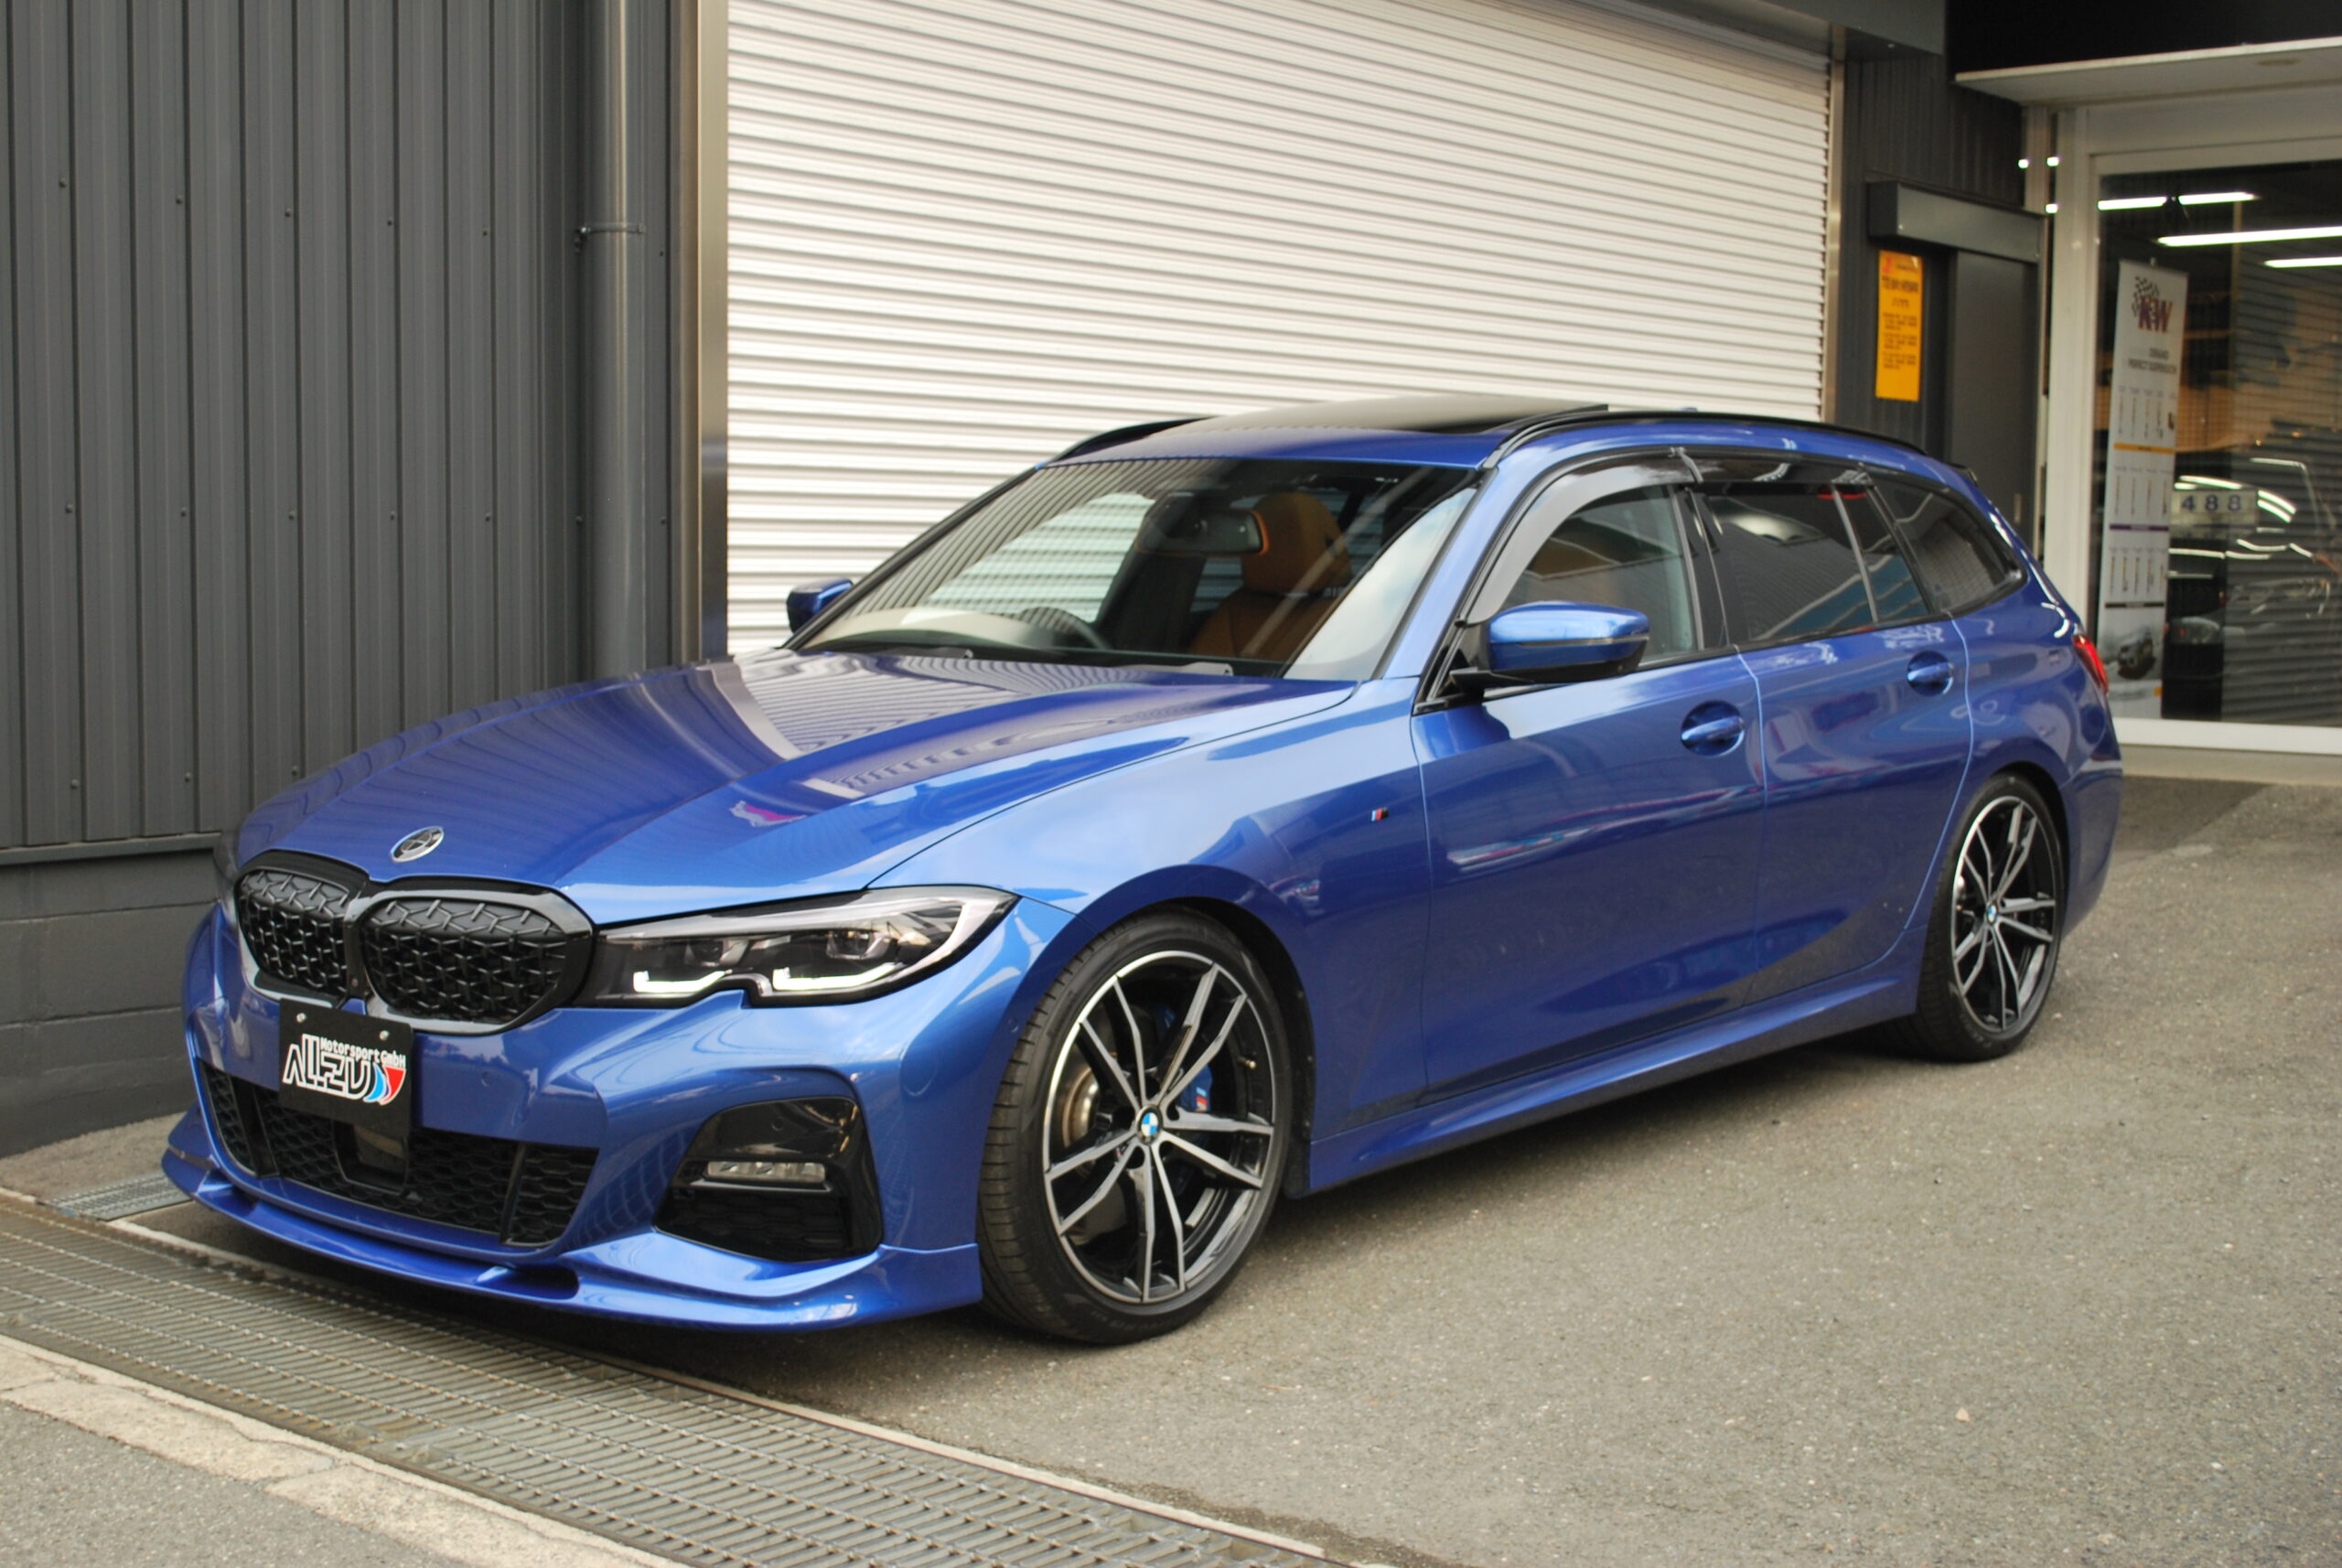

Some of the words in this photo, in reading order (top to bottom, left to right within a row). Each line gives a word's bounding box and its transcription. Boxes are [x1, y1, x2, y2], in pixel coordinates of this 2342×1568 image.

[2137, 295, 2173, 333] KW
[321, 1037, 381, 1064] Motorsport
[380, 1050, 406, 1069] GmbH
